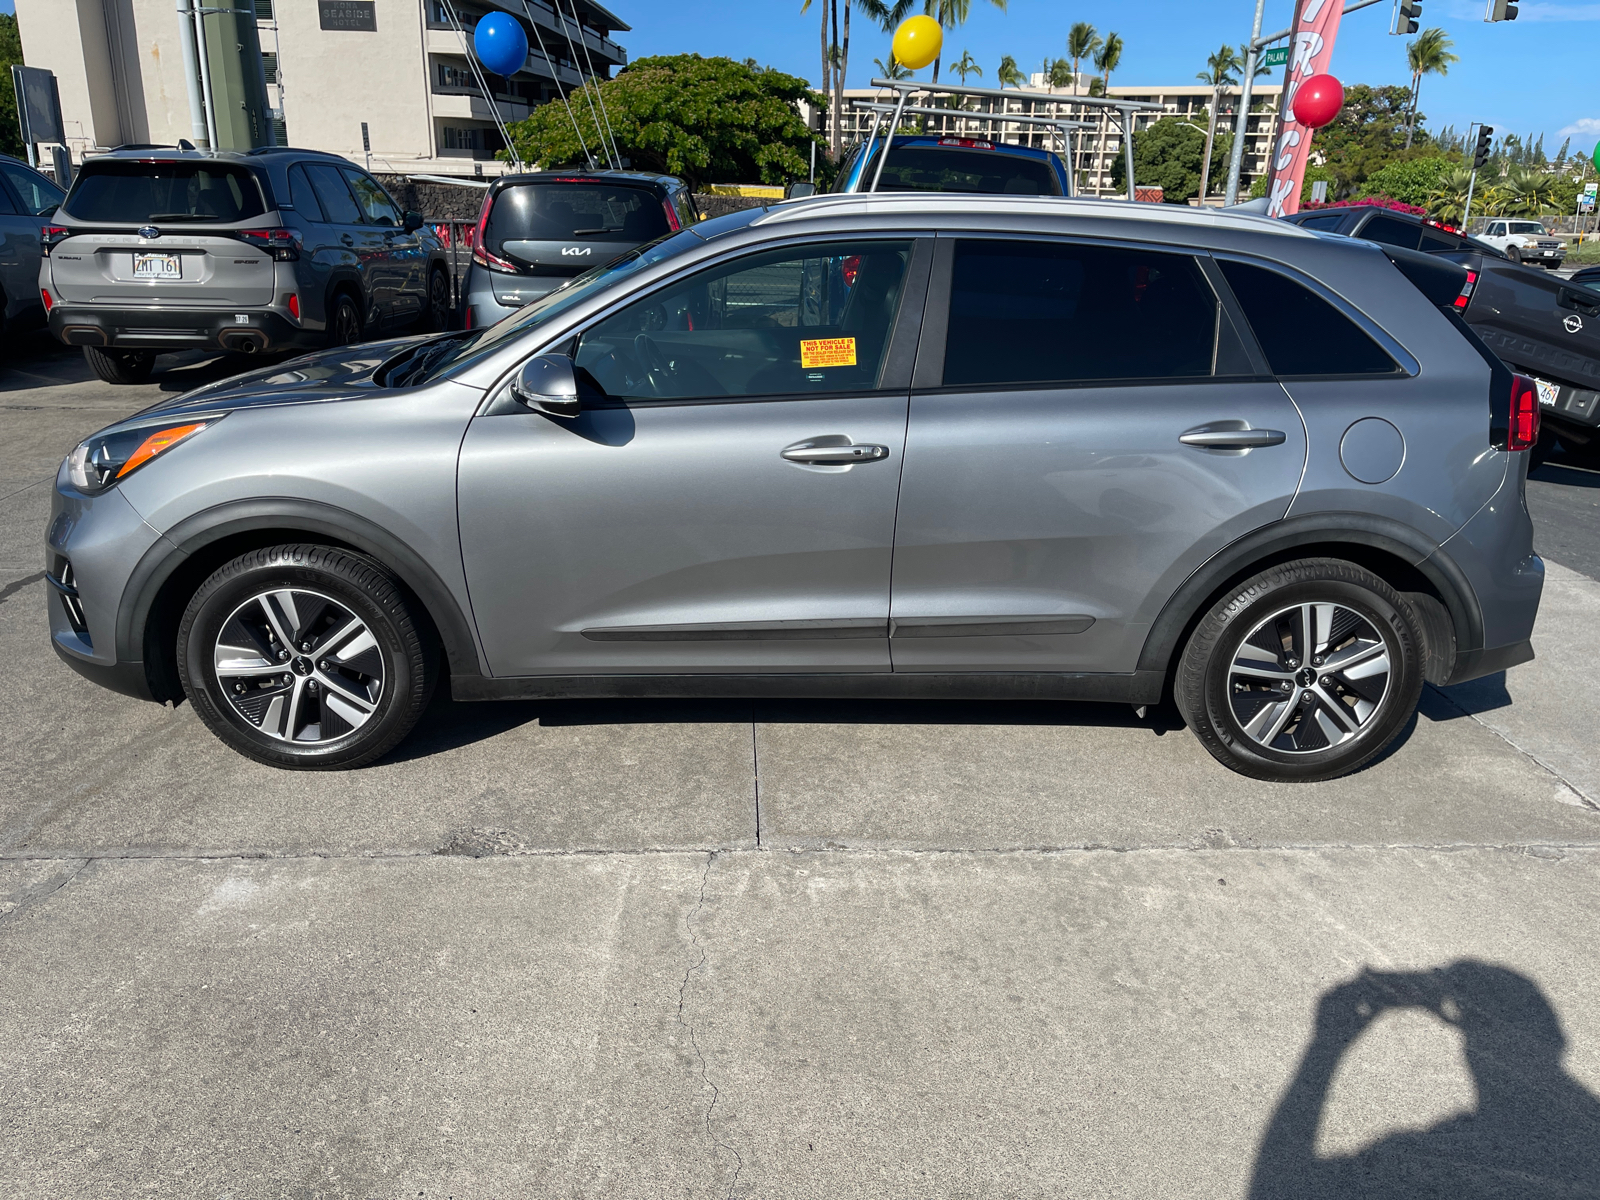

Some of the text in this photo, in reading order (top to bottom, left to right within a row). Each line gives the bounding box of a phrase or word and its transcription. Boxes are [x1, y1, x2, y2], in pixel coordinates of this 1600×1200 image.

[323, 9, 370, 19] SEASIDE
[1267, 52, 1285, 62] PALANI
[561, 247, 592, 256] KIA
[135, 259, 177, 272] ZMT 161
